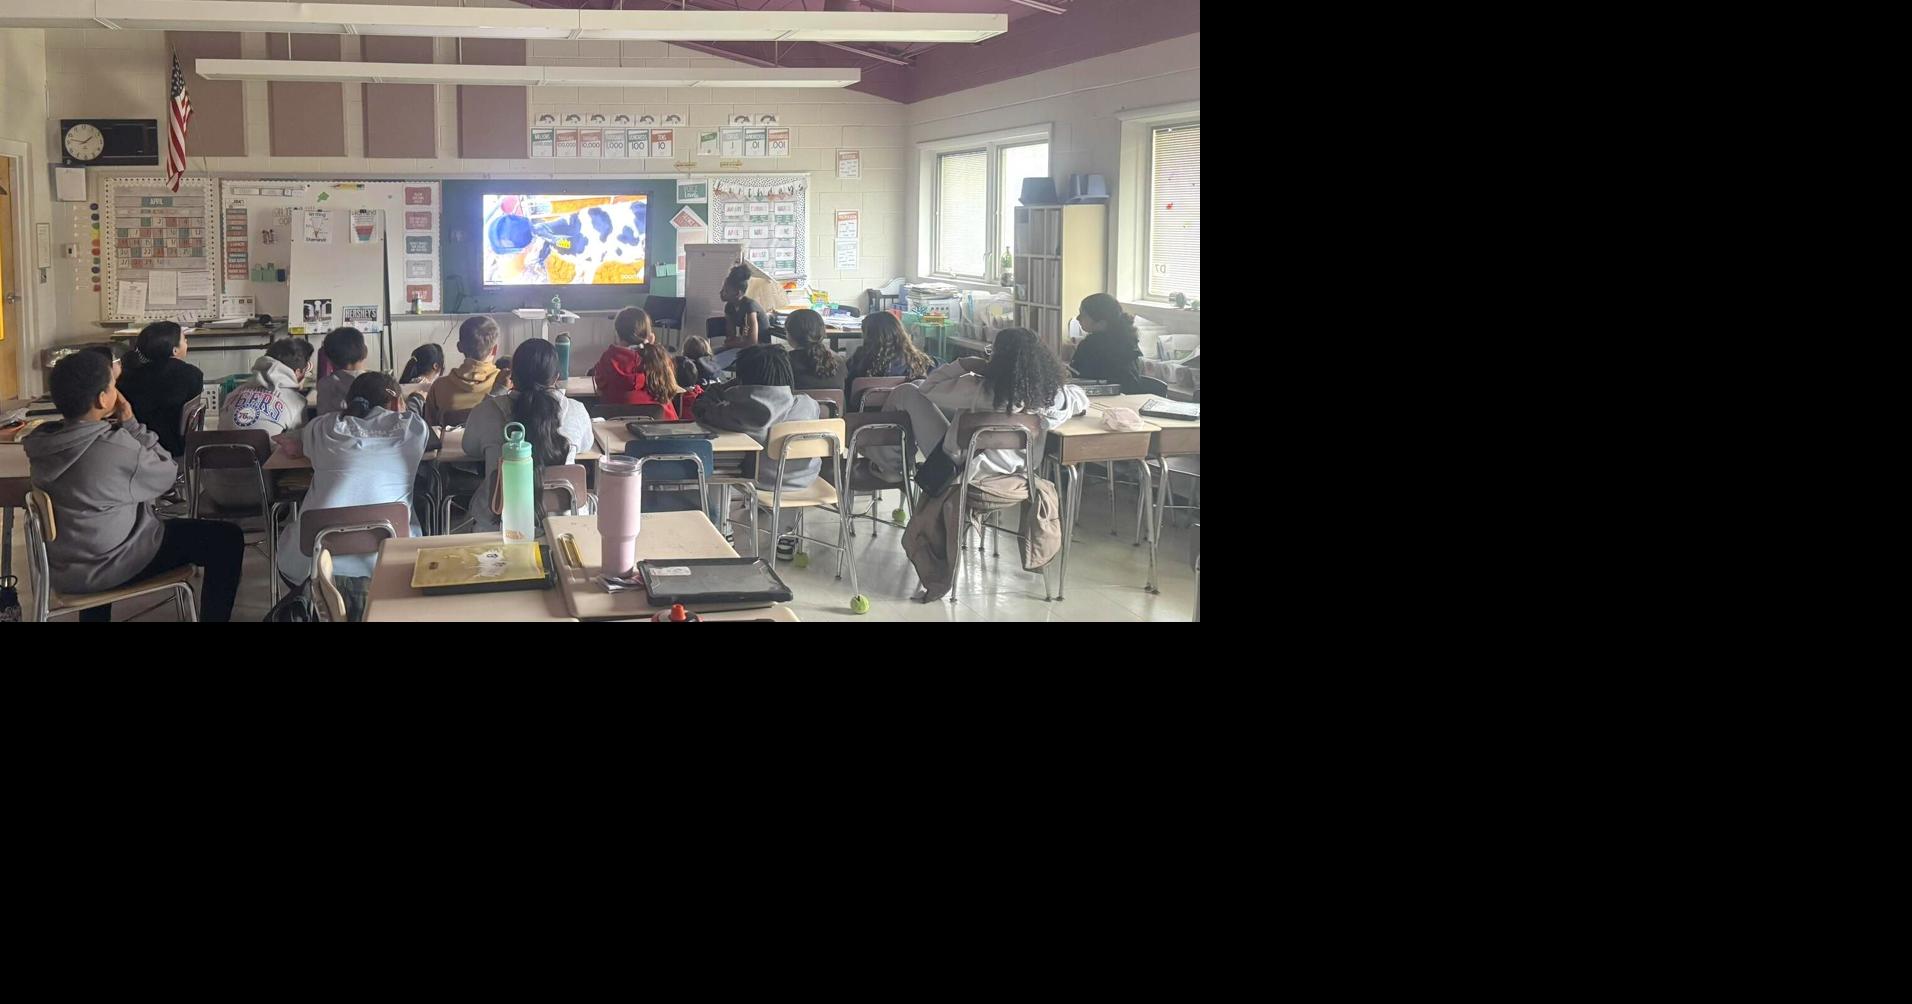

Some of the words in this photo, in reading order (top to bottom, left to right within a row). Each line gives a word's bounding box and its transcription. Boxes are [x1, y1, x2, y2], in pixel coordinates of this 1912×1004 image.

[631, 142, 644, 150] 100
[658, 142, 665, 150] 10
[346, 309, 377, 319] HERSHEY'S
